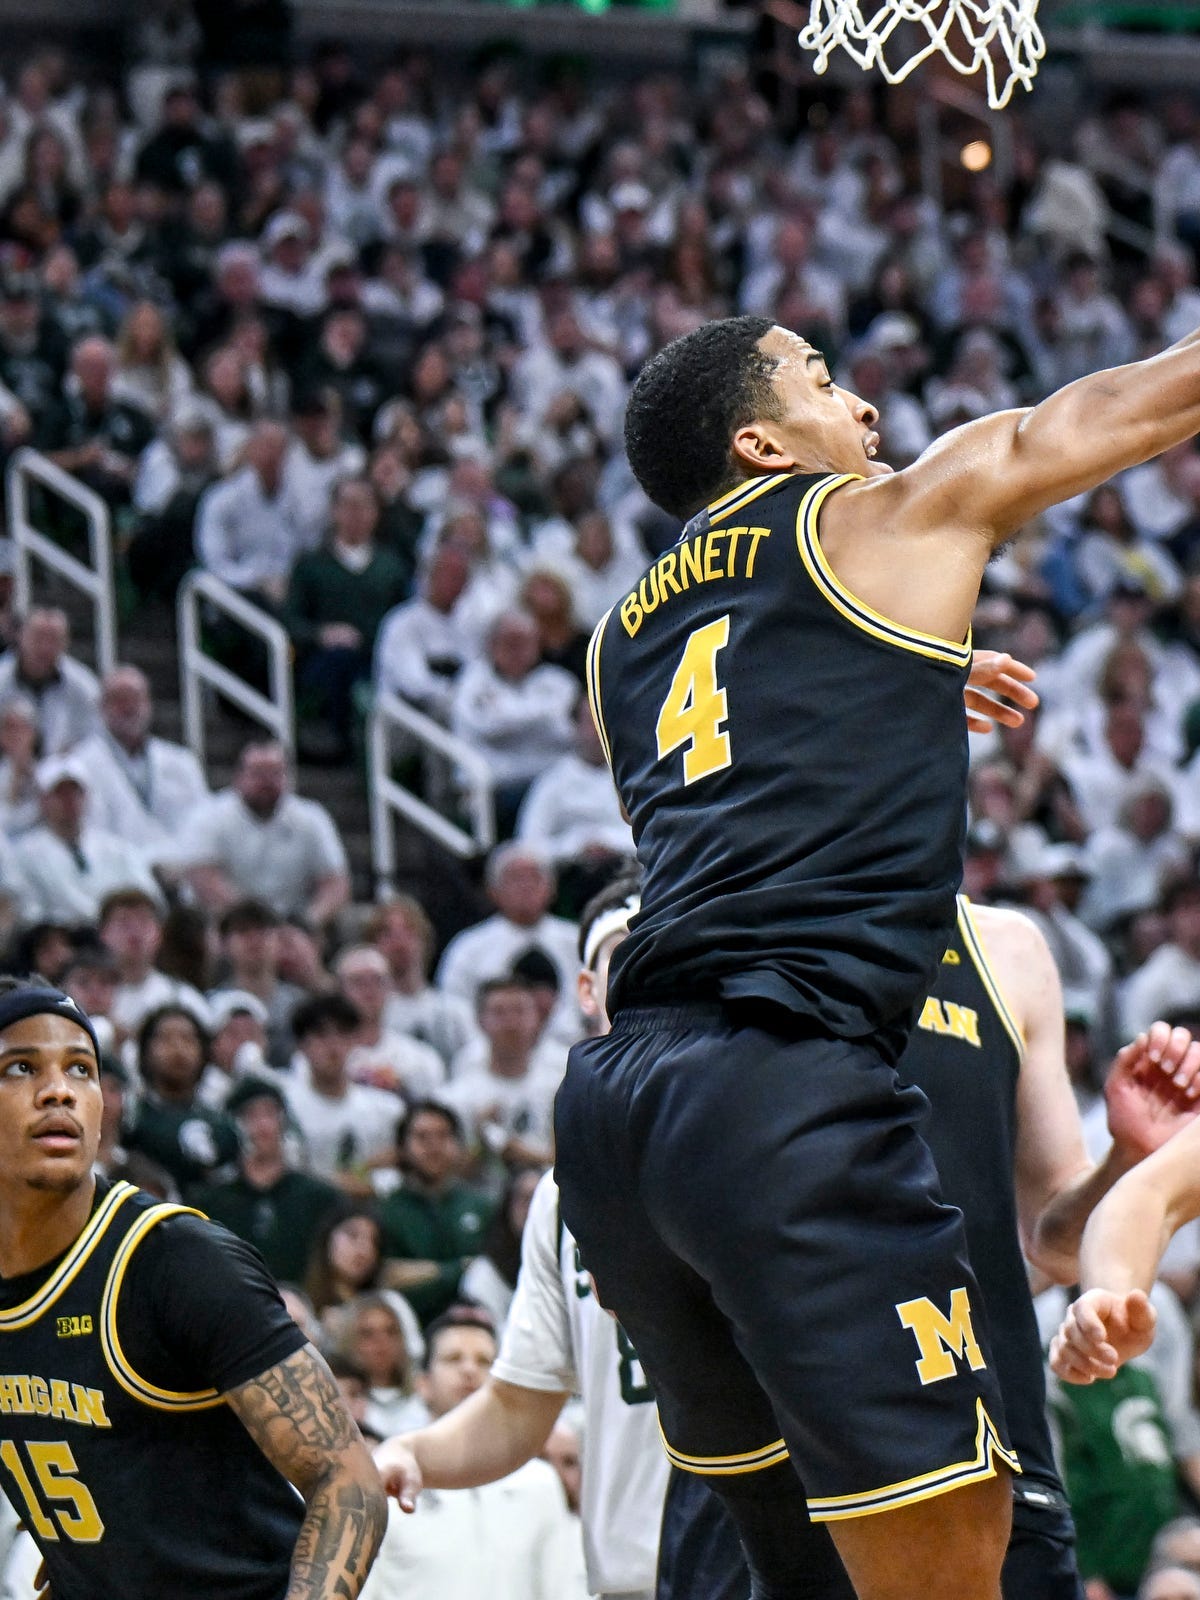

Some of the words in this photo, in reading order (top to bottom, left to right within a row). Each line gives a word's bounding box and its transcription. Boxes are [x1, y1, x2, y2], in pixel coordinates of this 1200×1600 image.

[620, 526, 772, 639] BURNETT
[655, 614, 732, 787] 4
[895, 1286, 987, 1386] M
[0, 1439, 105, 1543] 15
